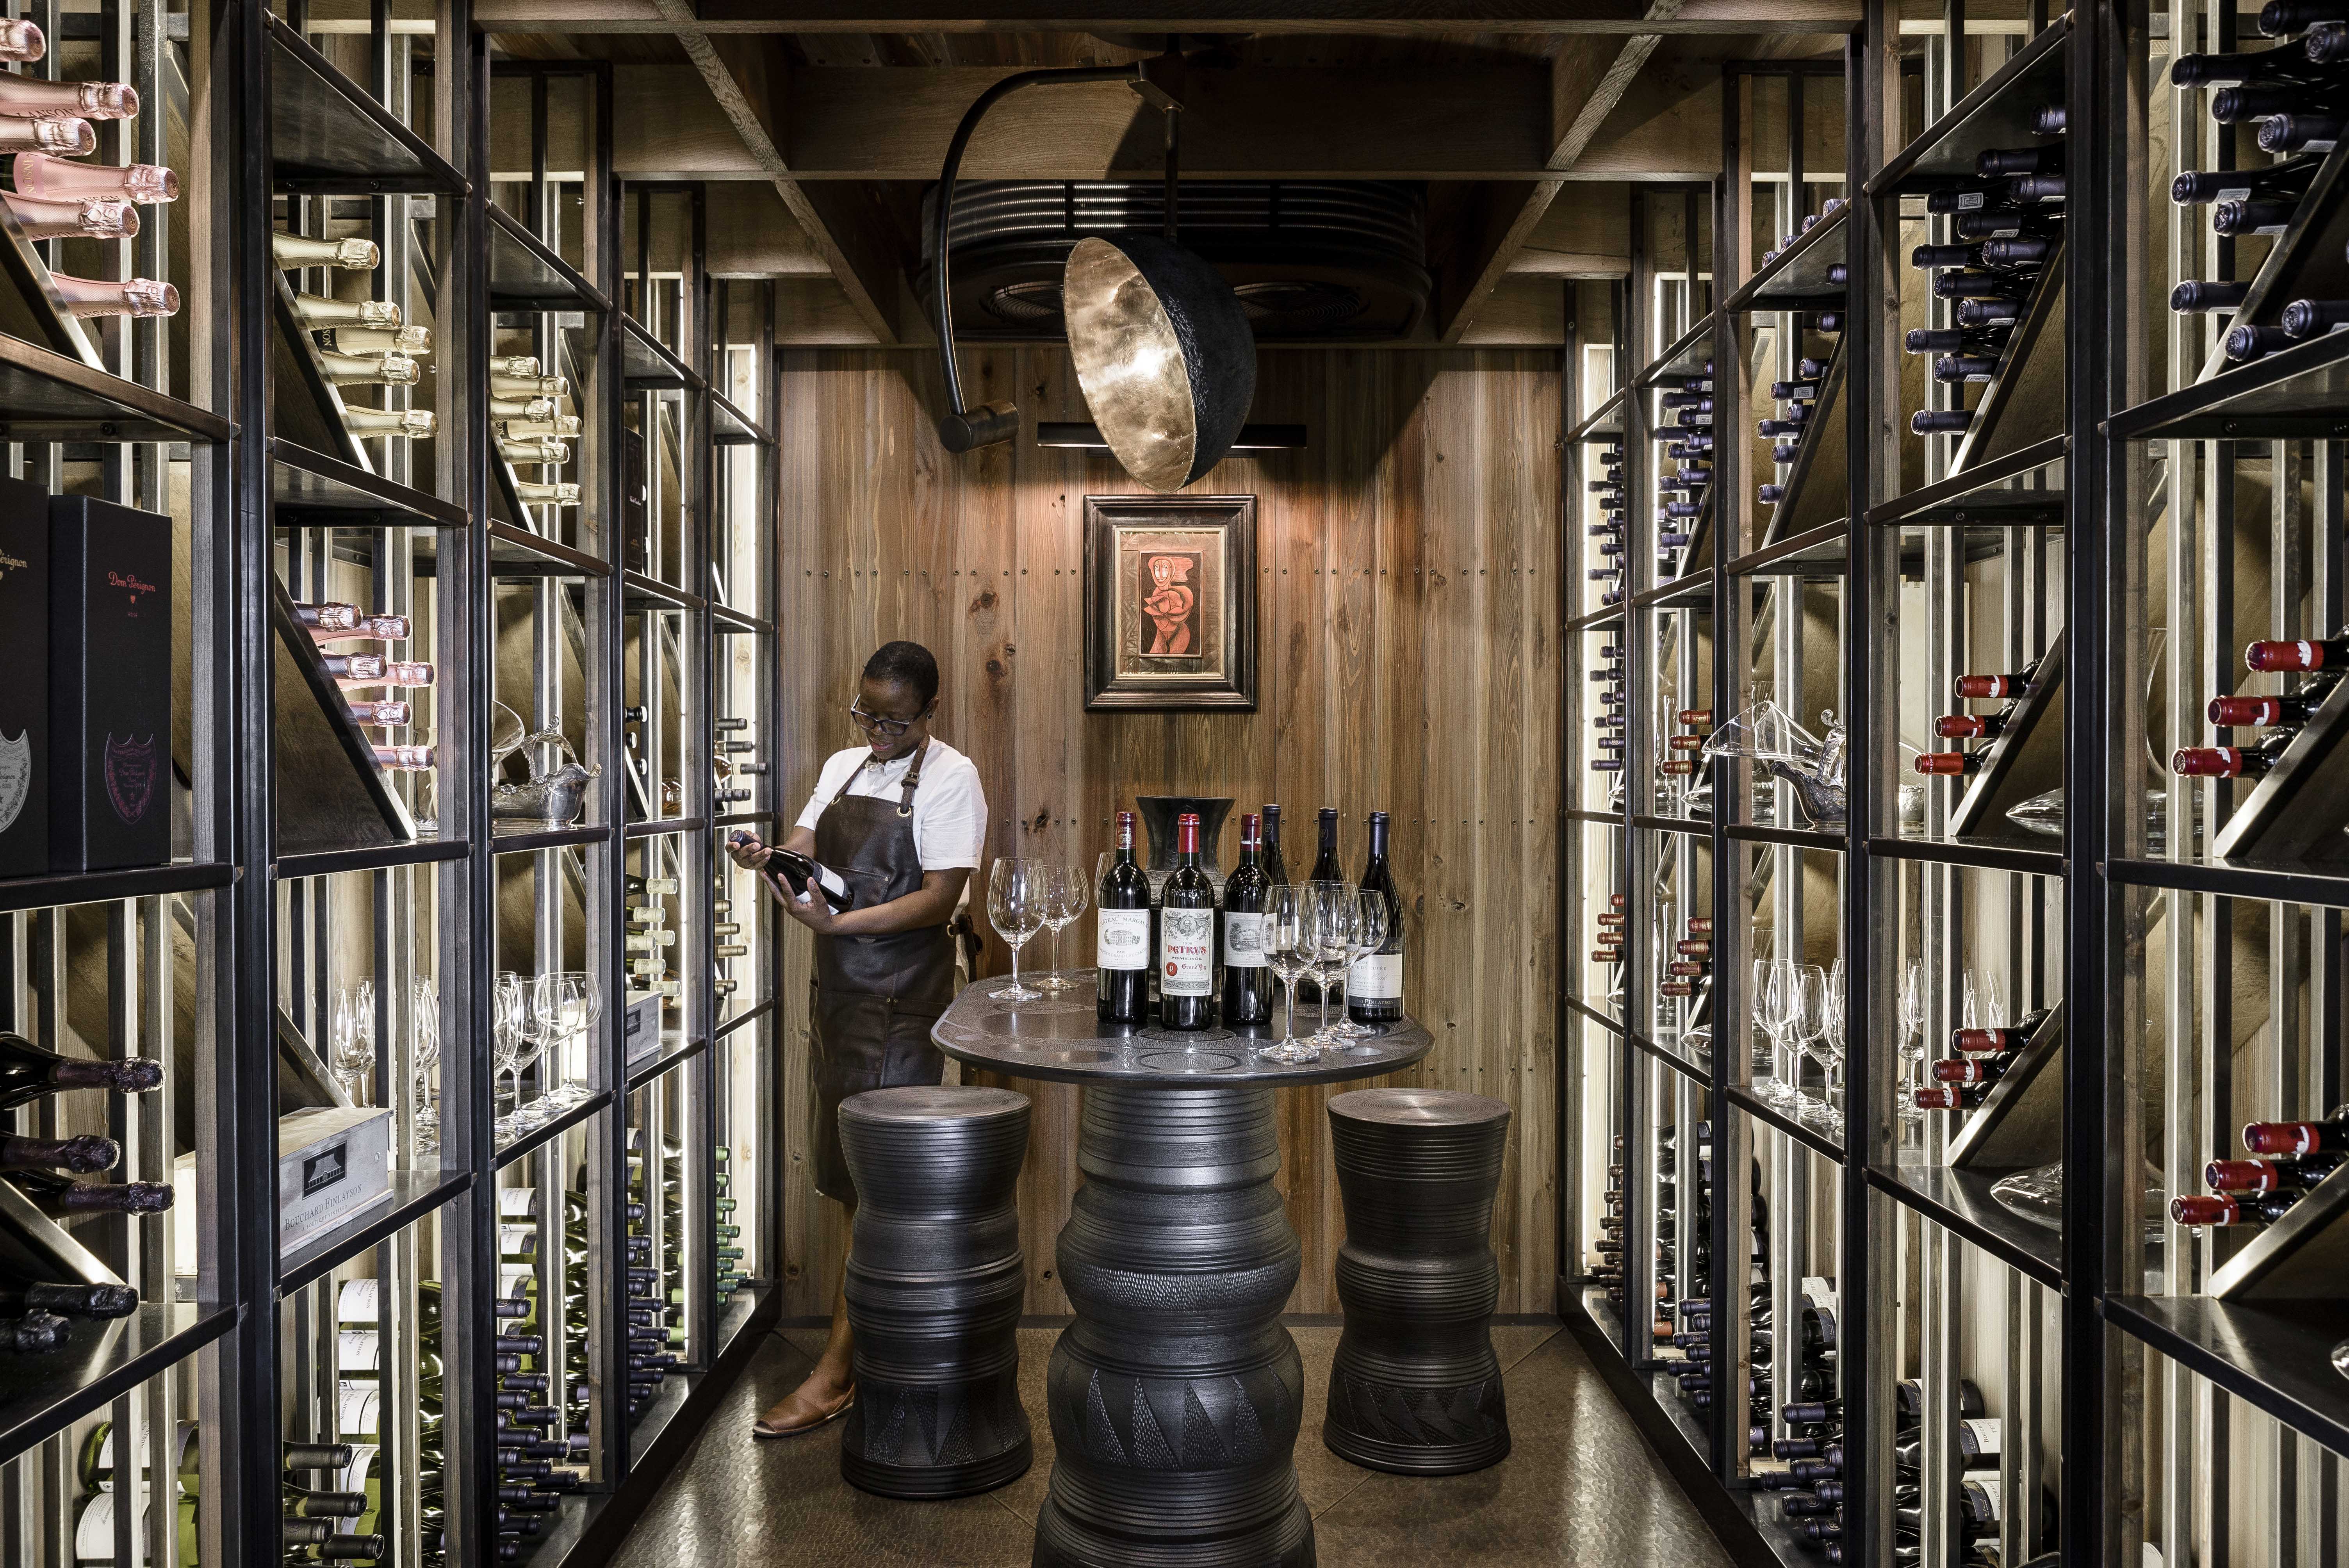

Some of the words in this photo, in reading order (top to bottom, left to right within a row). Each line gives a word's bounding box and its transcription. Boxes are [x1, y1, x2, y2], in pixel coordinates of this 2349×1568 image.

[322, 329, 332, 346] SON
[109, 571, 127, 586] Dom
[127, 574, 156, 595] Pérignon
[1123, 917, 1148, 928] MARGAUX
[285, 1204, 323, 1231] BOUCHARD
[325, 1184, 362, 1210] FINLAYSON
[306, 1215, 327, 1229] BOUTIQUE
[328, 1205, 348, 1217] VINEYARD
